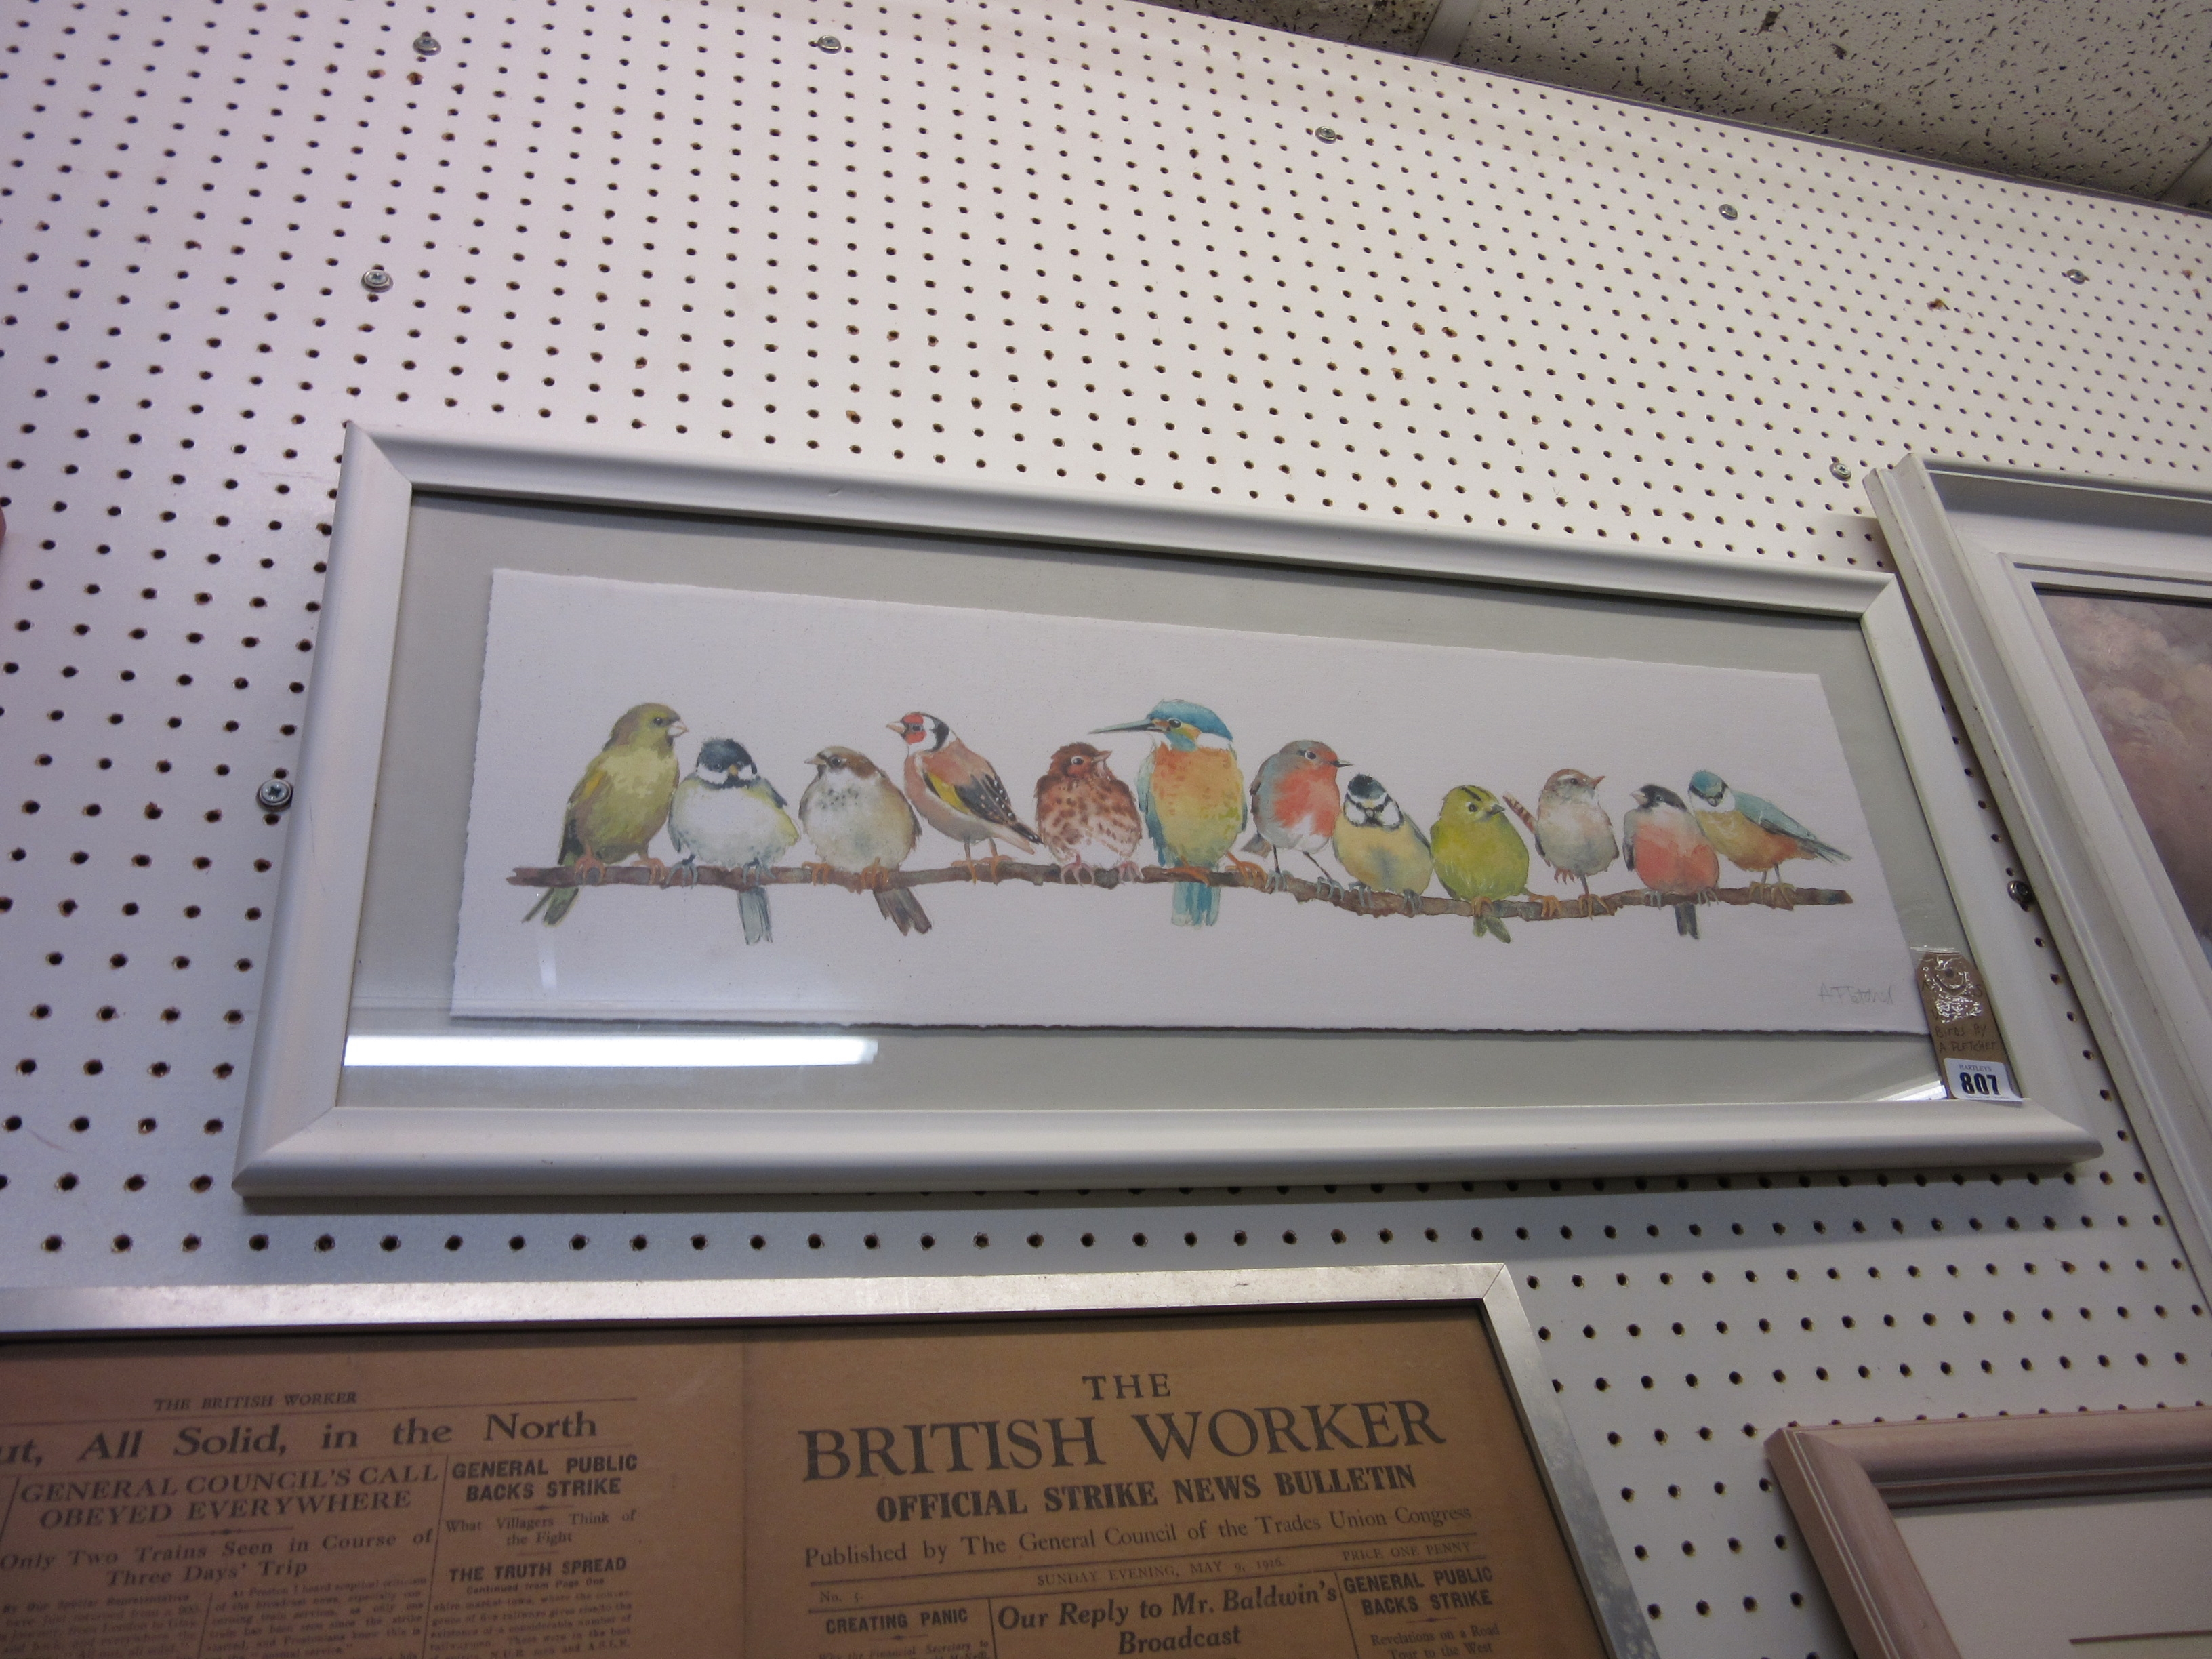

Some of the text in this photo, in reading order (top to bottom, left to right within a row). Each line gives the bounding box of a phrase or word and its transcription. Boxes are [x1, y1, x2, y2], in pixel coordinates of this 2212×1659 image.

[1960, 1072, 2000, 1095] 807
[1082, 1373, 1170, 1400] THE
[154, 1391, 357, 1411] THE BRITISH WORKER
[77, 1430, 144, 1461] All
[173, 1422, 287, 1456] Solid,
[321, 1424, 358, 1449] in
[392, 1417, 454, 1445] the
[483, 1410, 597, 1442] North
[798, 1399, 1447, 1481] BRITISH WORKER
[451, 1454, 638, 1480] GENERAL PUBLIC
[21, 1464, 438, 1503] GENERAL COUNCIL'S CALL
[466, 1477, 621, 1503] BACKS STRIKE
[876, 1464, 1416, 1523] OFFICIAL STRIKE NEWS BULLETIN
[39, 1490, 411, 1529] OBEYED EVERYWHERE
[445, 1509, 637, 1533] What Villagers Think of
[0, 1528, 434, 1571] Only Two Trains Seen in Course of
[507, 1532, 573, 1546] the Fight
[804, 1506, 1473, 1568] Published by The General Council of the Trades Union Congress
[1343, 1542, 1471, 1561] PRICE ONE PENNY
[107, 1570, 172, 1587] Three
[258, 1560, 308, 1577] Trip
[449, 1557, 627, 1582] THE TRUTH SPREAD
[1037, 1570, 1099, 1586] SUNDAY
[1109, 1561, 1181, 1580] EVENING,
[1191, 1561, 1223, 1574] MAY
[1343, 1566, 1494, 1594] GENERAL PUBLIC
[820, 1592, 842, 1603] No.
[998, 1580, 1338, 1631] Our Reply to Mr. Baldwin's
[1361, 1589, 1493, 1616] BACKS STRIKE
[826, 1608, 968, 1635] CREATING PANIC
[1371, 1623, 1500, 1646] Revelations on a Road
[1118, 1625, 1242, 1655] Broadcast
[1387, 1641, 1493, 1659] Tour to the West
